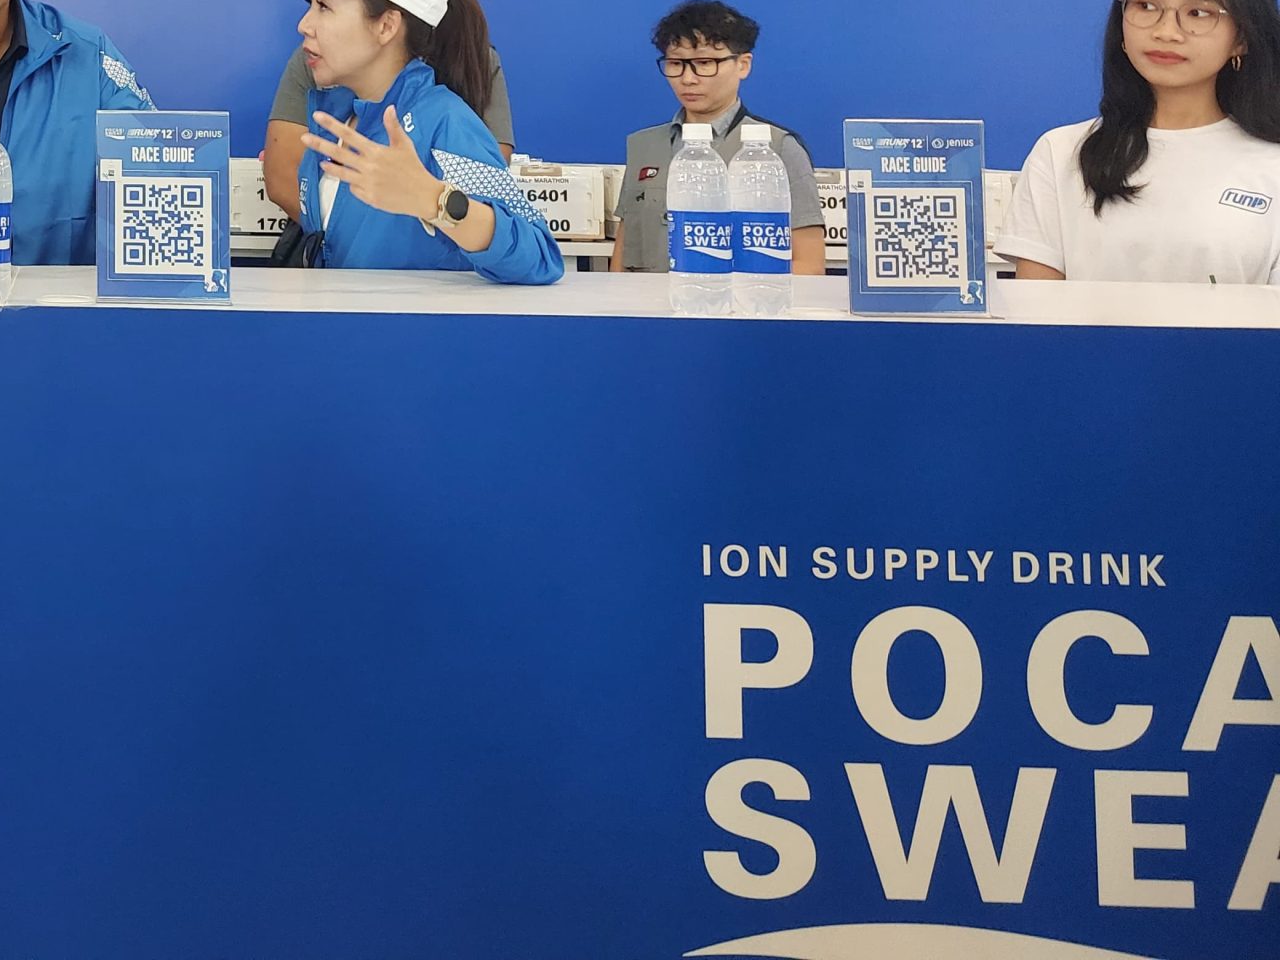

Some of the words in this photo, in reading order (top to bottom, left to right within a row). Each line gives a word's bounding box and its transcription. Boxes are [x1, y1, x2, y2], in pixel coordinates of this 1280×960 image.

[132, 147, 160, 162] RACE
[162, 147, 195, 163] GUIDE
[881, 157, 910, 173] RACE
[913, 157, 946, 173] GUIDE
[257, 218, 287, 230] 176
[683, 225, 731, 236] POCAR
[742, 226, 790, 237] POCAR
[683, 235, 731, 247] SWEAT
[742, 236, 791, 247] SWEAT
[702, 544, 789, 577] ION
[811, 546, 994, 582] SUPPLY
[1012, 551, 1167, 587] DRINK
[703, 602, 1280, 752] POCA
[702, 757, 1280, 911] SWE
